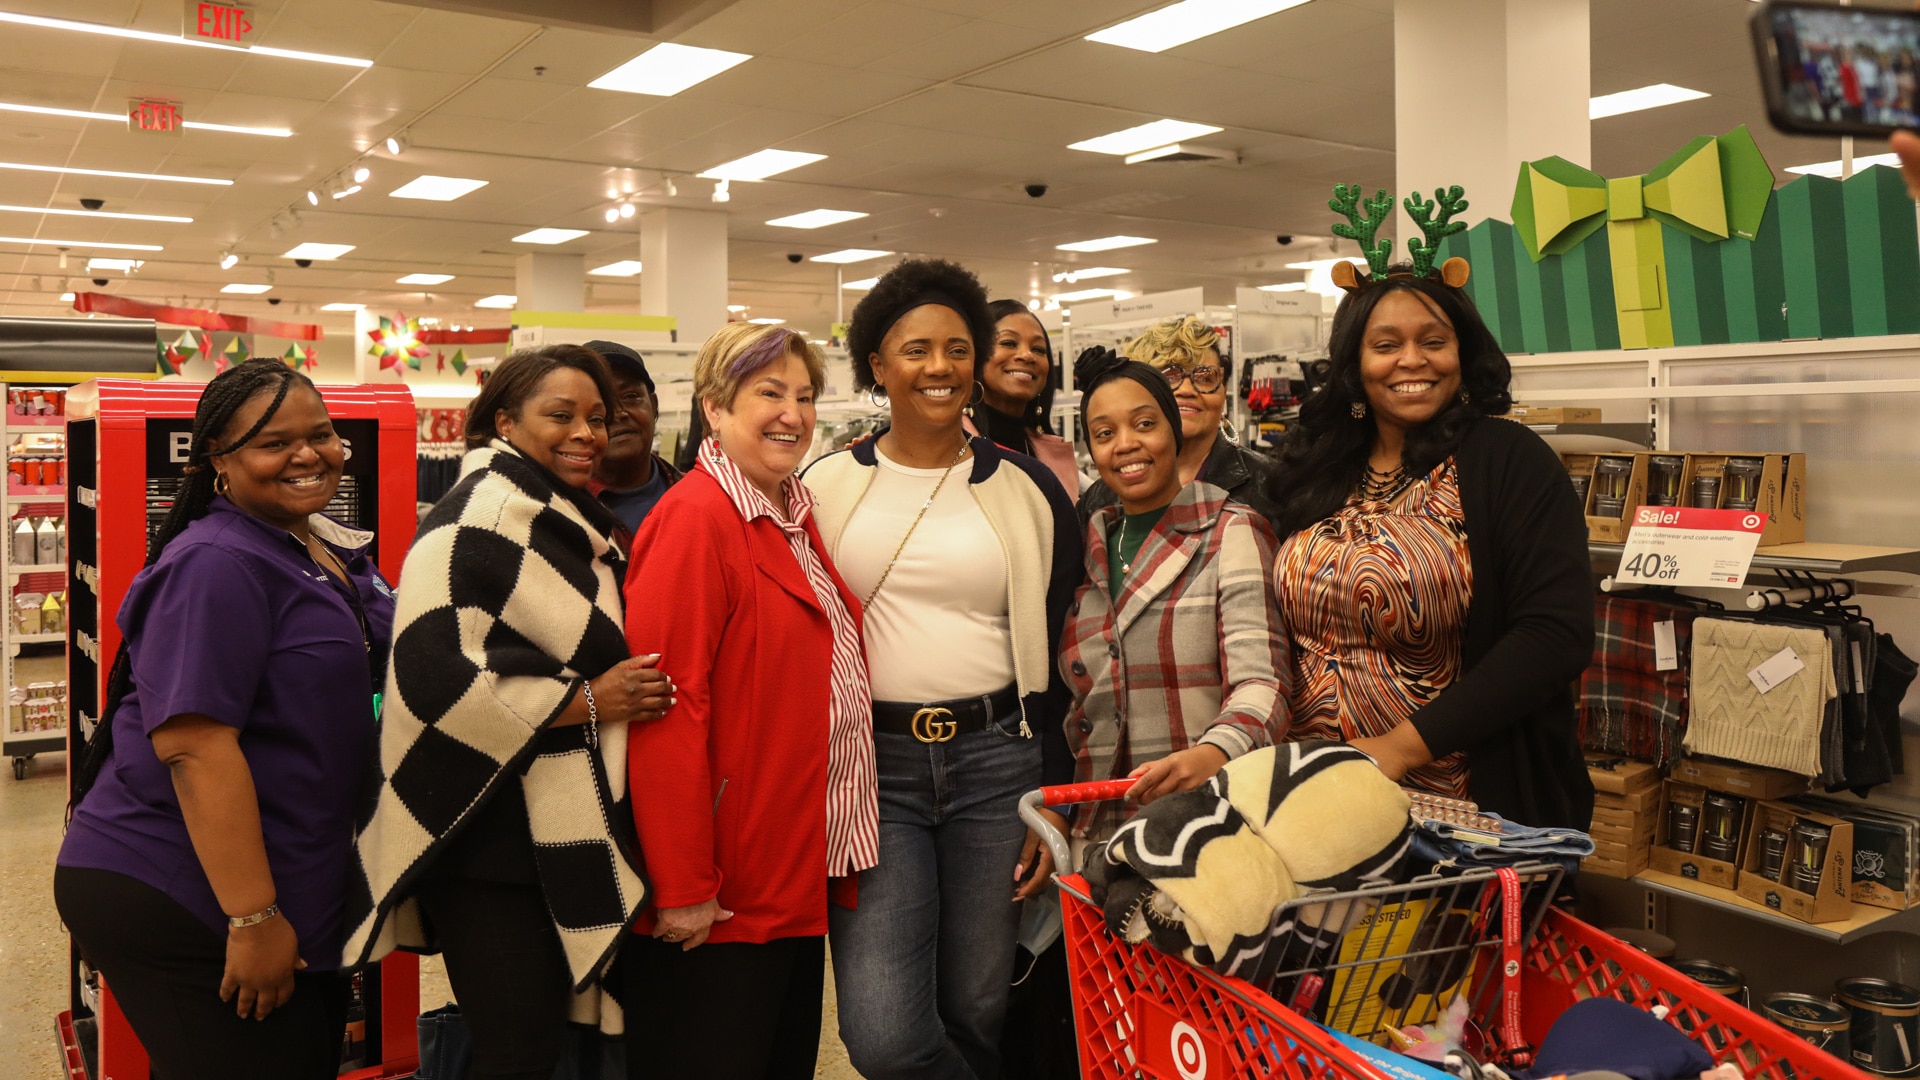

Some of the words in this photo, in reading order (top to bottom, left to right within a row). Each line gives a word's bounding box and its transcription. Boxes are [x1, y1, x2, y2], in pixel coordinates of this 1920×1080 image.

[197, 2, 245, 42] EXIT
[138, 102, 177, 132] EXIT
[1638, 509, 1680, 525] Sale!
[1652, 532, 1681, 540] outerwear
[1695, 534, 1734, 542] cold-weather
[1658, 568, 1680, 580] off
